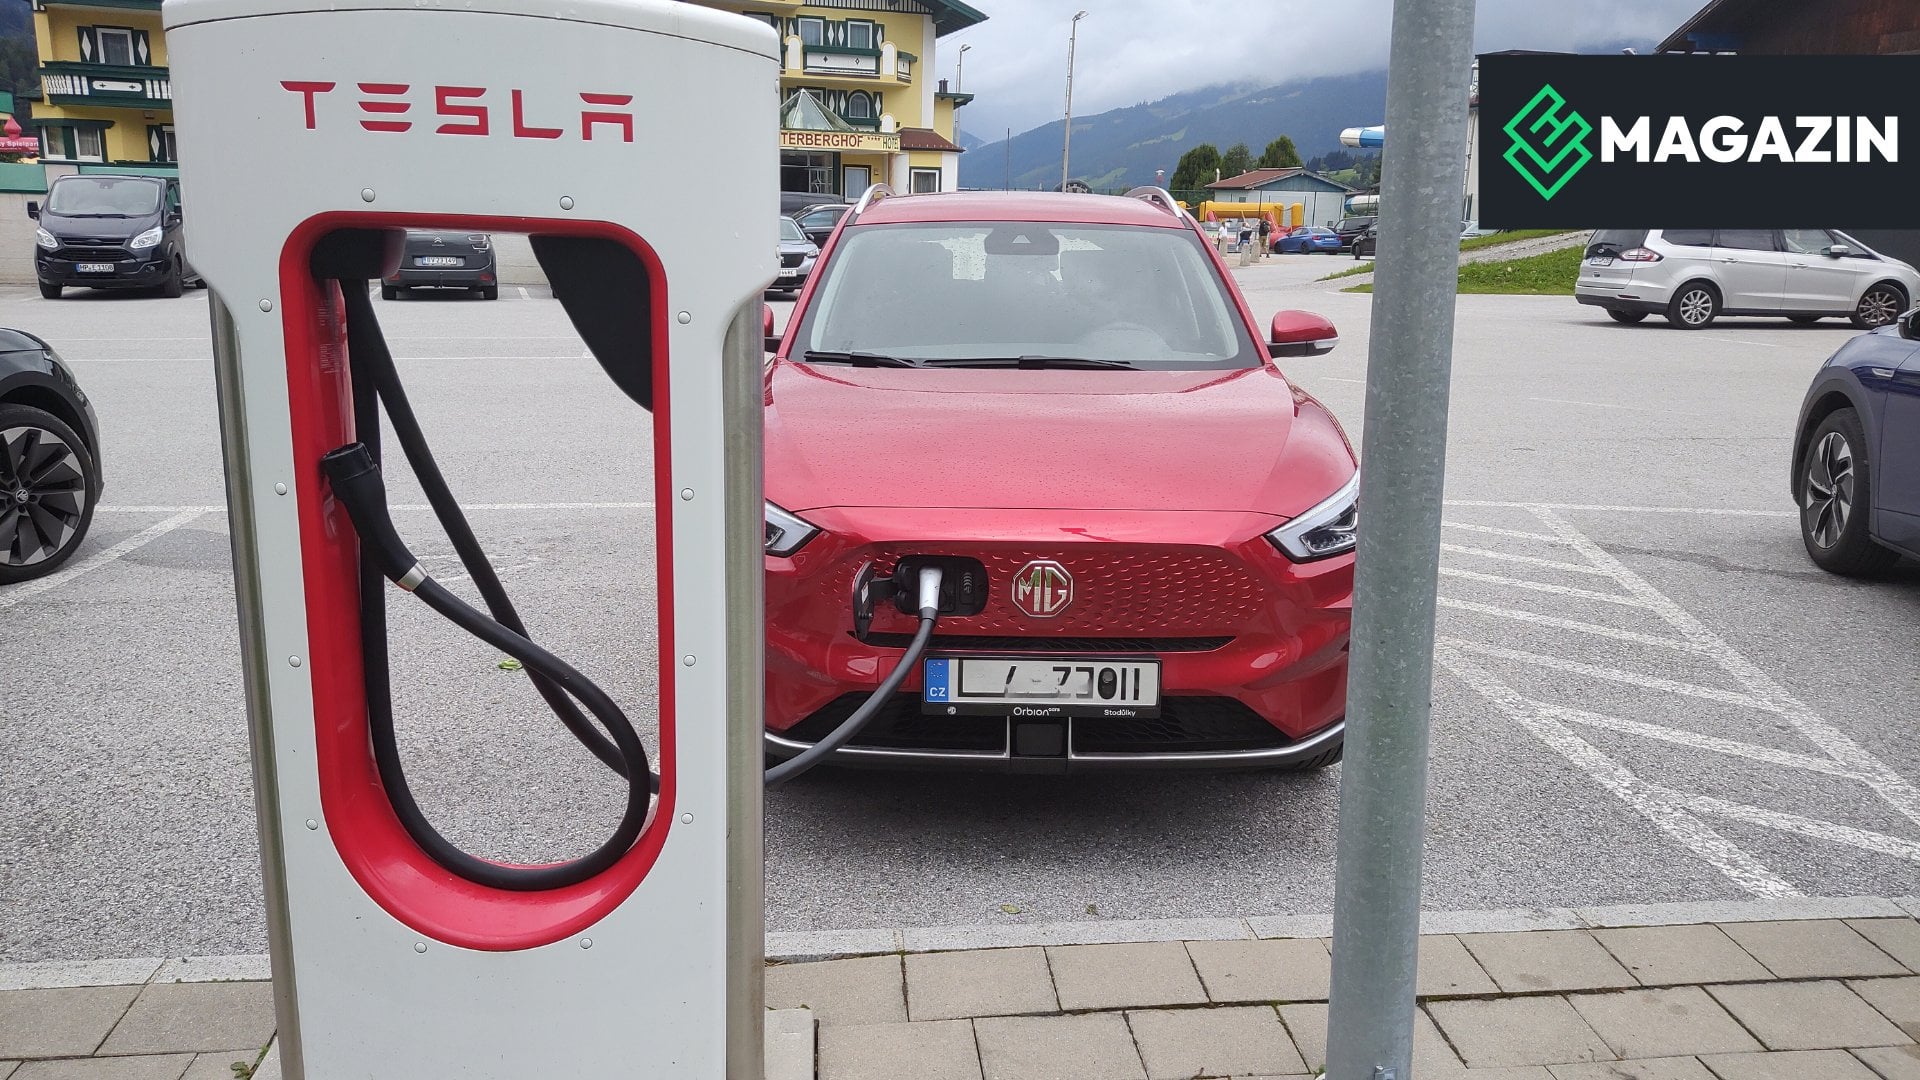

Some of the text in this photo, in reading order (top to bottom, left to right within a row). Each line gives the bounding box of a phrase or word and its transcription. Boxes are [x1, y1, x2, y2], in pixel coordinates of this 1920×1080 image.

[279, 80, 634, 143] TESLA
[780, 132, 899, 150] TERBERGHOF HOTEL
[1018, 565, 1068, 613] MG
[929, 687, 946, 698] CZ
[1104, 709, 1136, 717] Stodůlky
